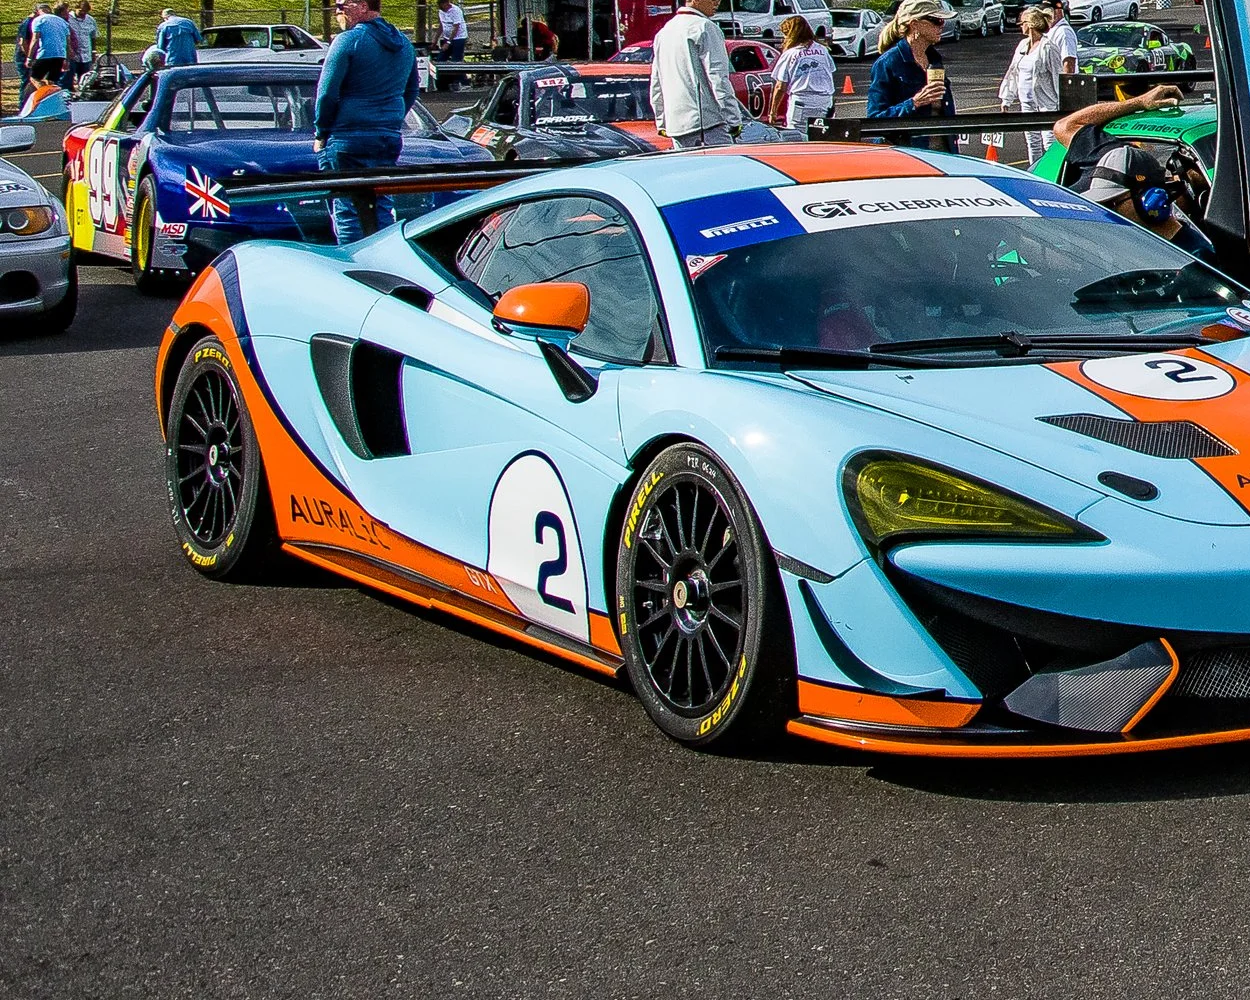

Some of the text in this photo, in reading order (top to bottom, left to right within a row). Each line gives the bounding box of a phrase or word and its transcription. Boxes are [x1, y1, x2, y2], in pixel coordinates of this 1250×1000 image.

[89, 135, 119, 232] 99
[802, 198, 1011, 219] GT CELEBRATION
[1029, 199, 1093, 213] PIRELLI
[161, 223, 186, 235] MSD
[700, 215, 779, 239] PIRELLI
[202, 347, 231, 368] ZERO
[1145, 359, 1218, 384] 2
[183, 542, 217, 567] PIRELLI
[535, 510, 577, 615] 2
[701, 675, 740, 735] ZERO
